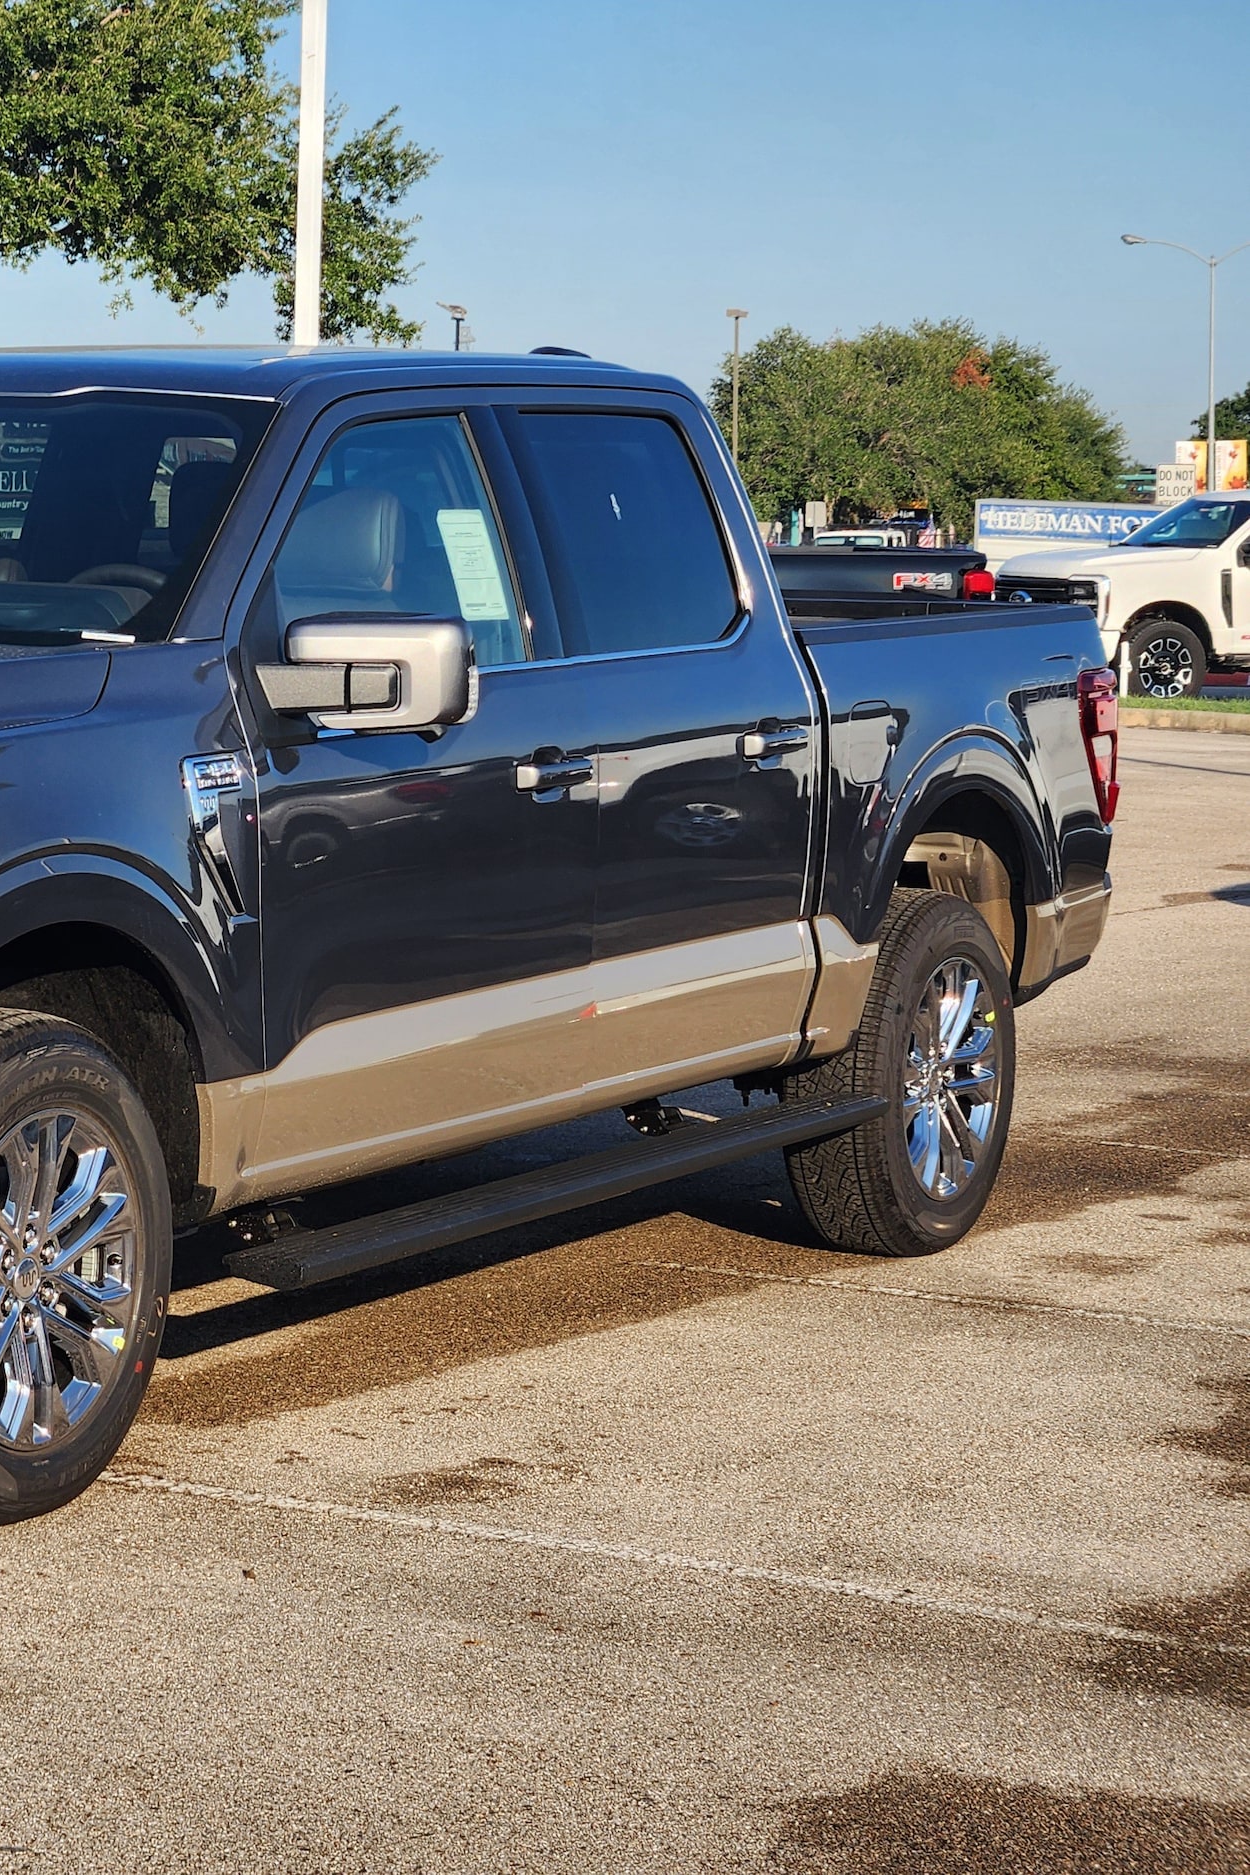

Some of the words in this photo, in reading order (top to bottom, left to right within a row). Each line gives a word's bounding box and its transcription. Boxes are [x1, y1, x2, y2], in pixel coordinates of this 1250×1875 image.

[1159, 470, 1172, 481] DO
[1175, 470, 1194, 481] NOT
[1158, 486, 1194, 497] BLOCK
[985, 509, 1104, 534] HELFMAN
[893, 572, 952, 591] FX4
[63, 1066, 110, 1093] ATR
